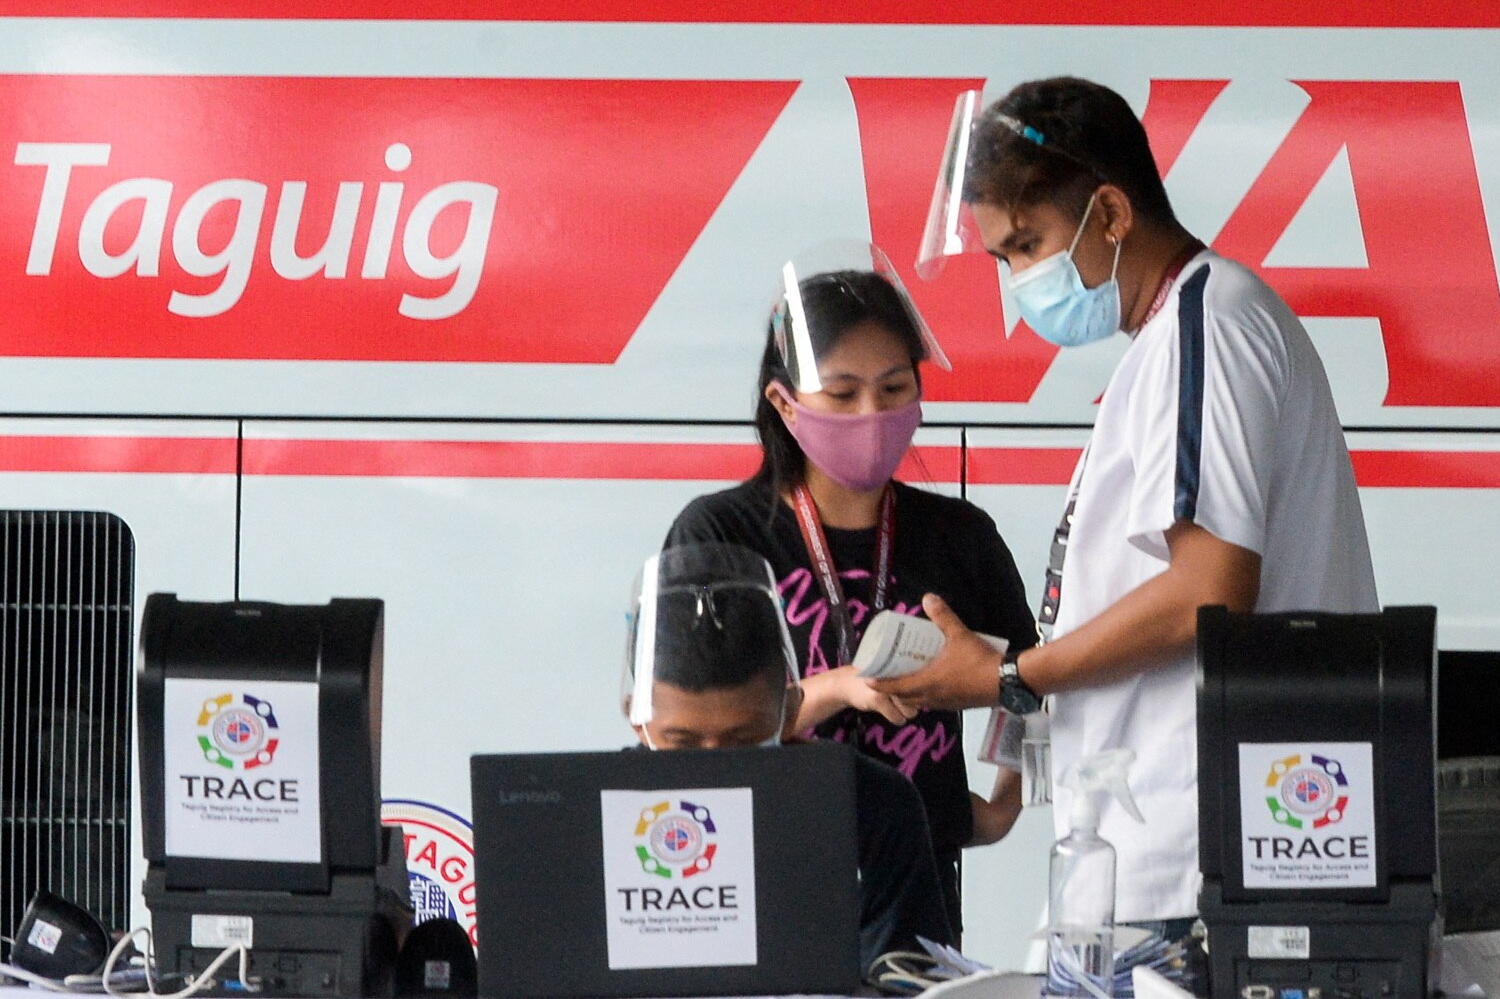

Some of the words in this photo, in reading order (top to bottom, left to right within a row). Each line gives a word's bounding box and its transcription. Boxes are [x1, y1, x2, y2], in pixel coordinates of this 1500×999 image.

[13, 142, 499, 320] Taguig
[180, 775, 298, 802] TRACE
[1248, 836, 1369, 859] TRACE
[617, 885, 738, 911] TRACE
